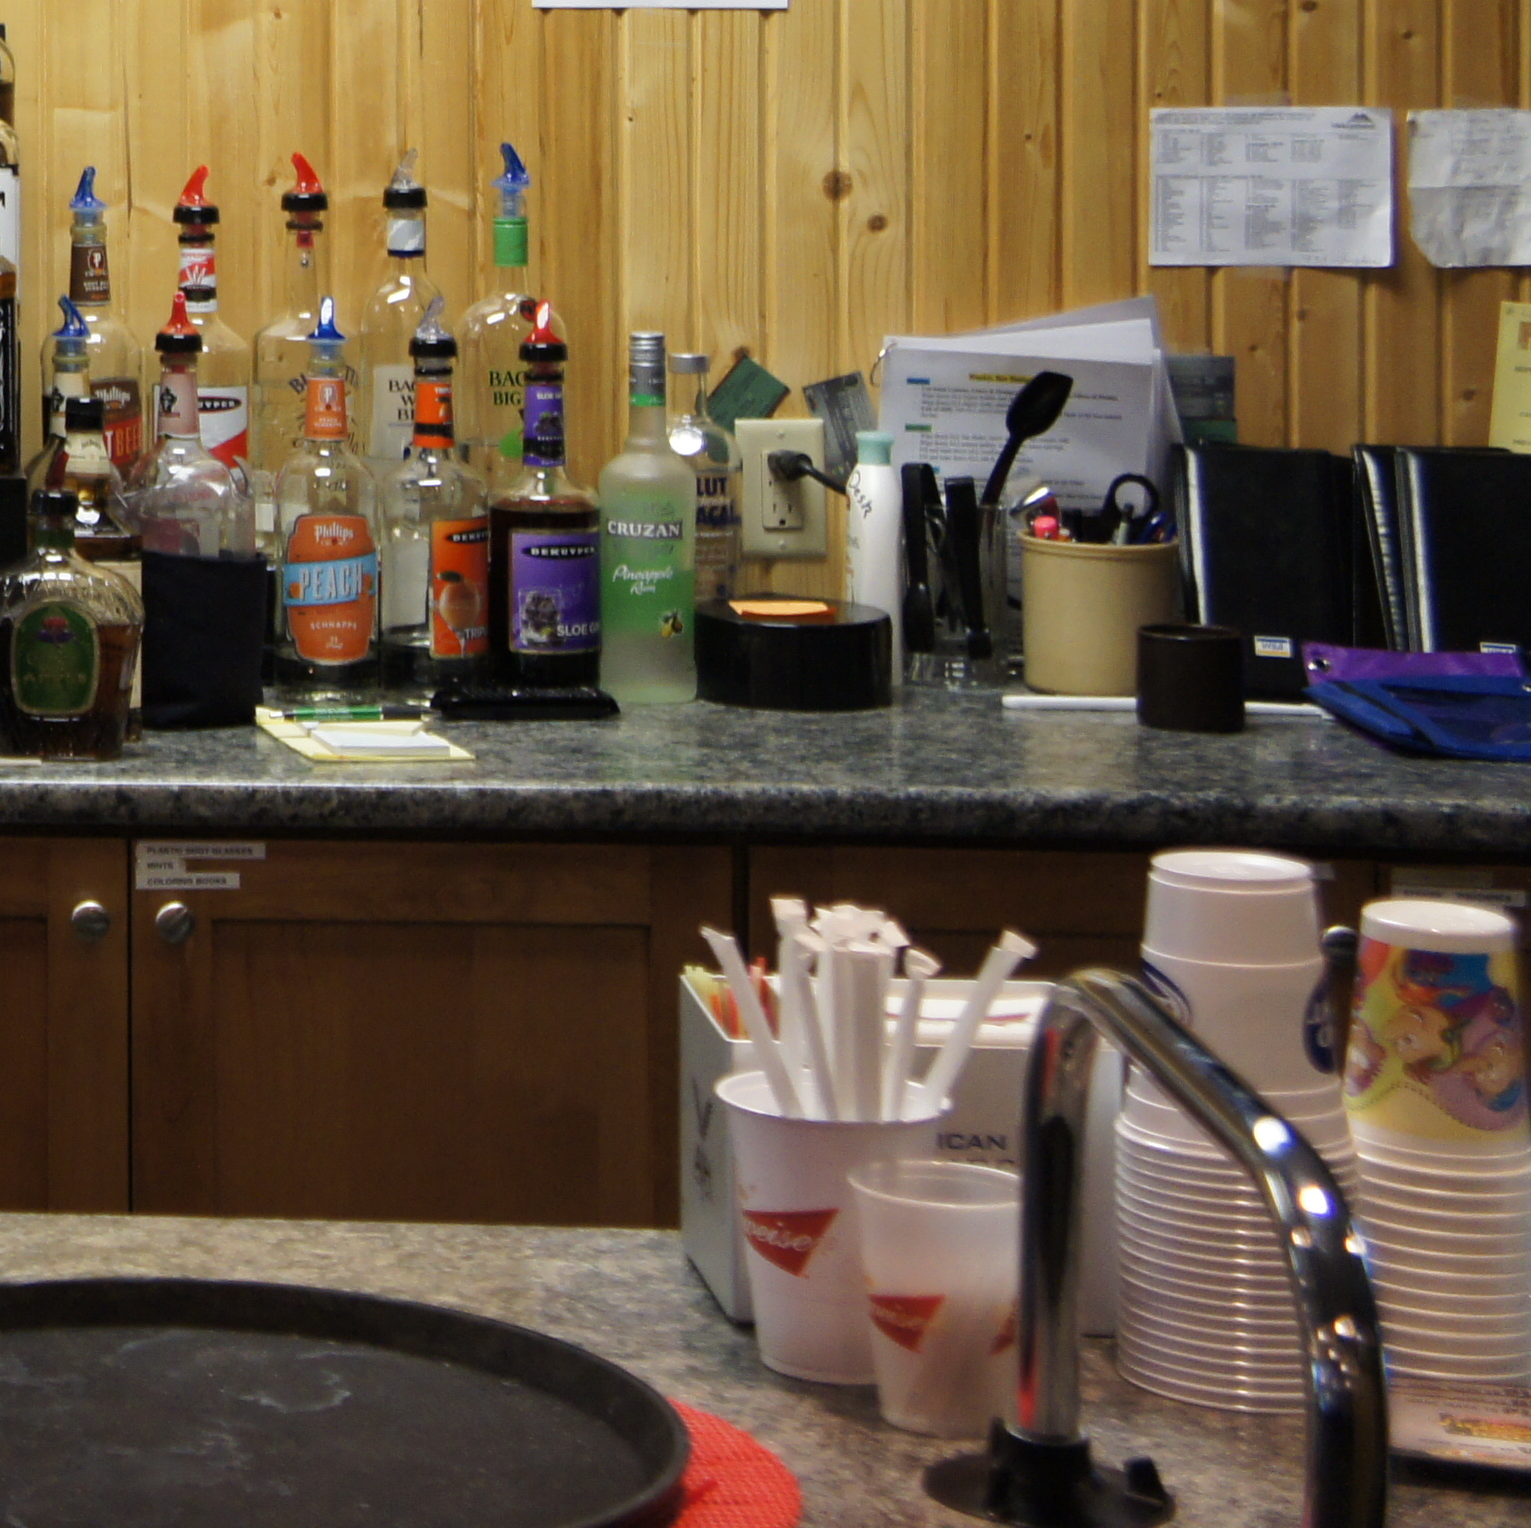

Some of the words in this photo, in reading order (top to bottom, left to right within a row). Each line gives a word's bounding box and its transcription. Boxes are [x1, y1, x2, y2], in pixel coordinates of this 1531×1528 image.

[314, 524, 354, 542] Phillips
[608, 522, 681, 538] CRUZAN
[300, 563, 363, 601] PEACH
[612, 564, 674, 583] Pineapple
[557, 624, 588, 637] SLOE
